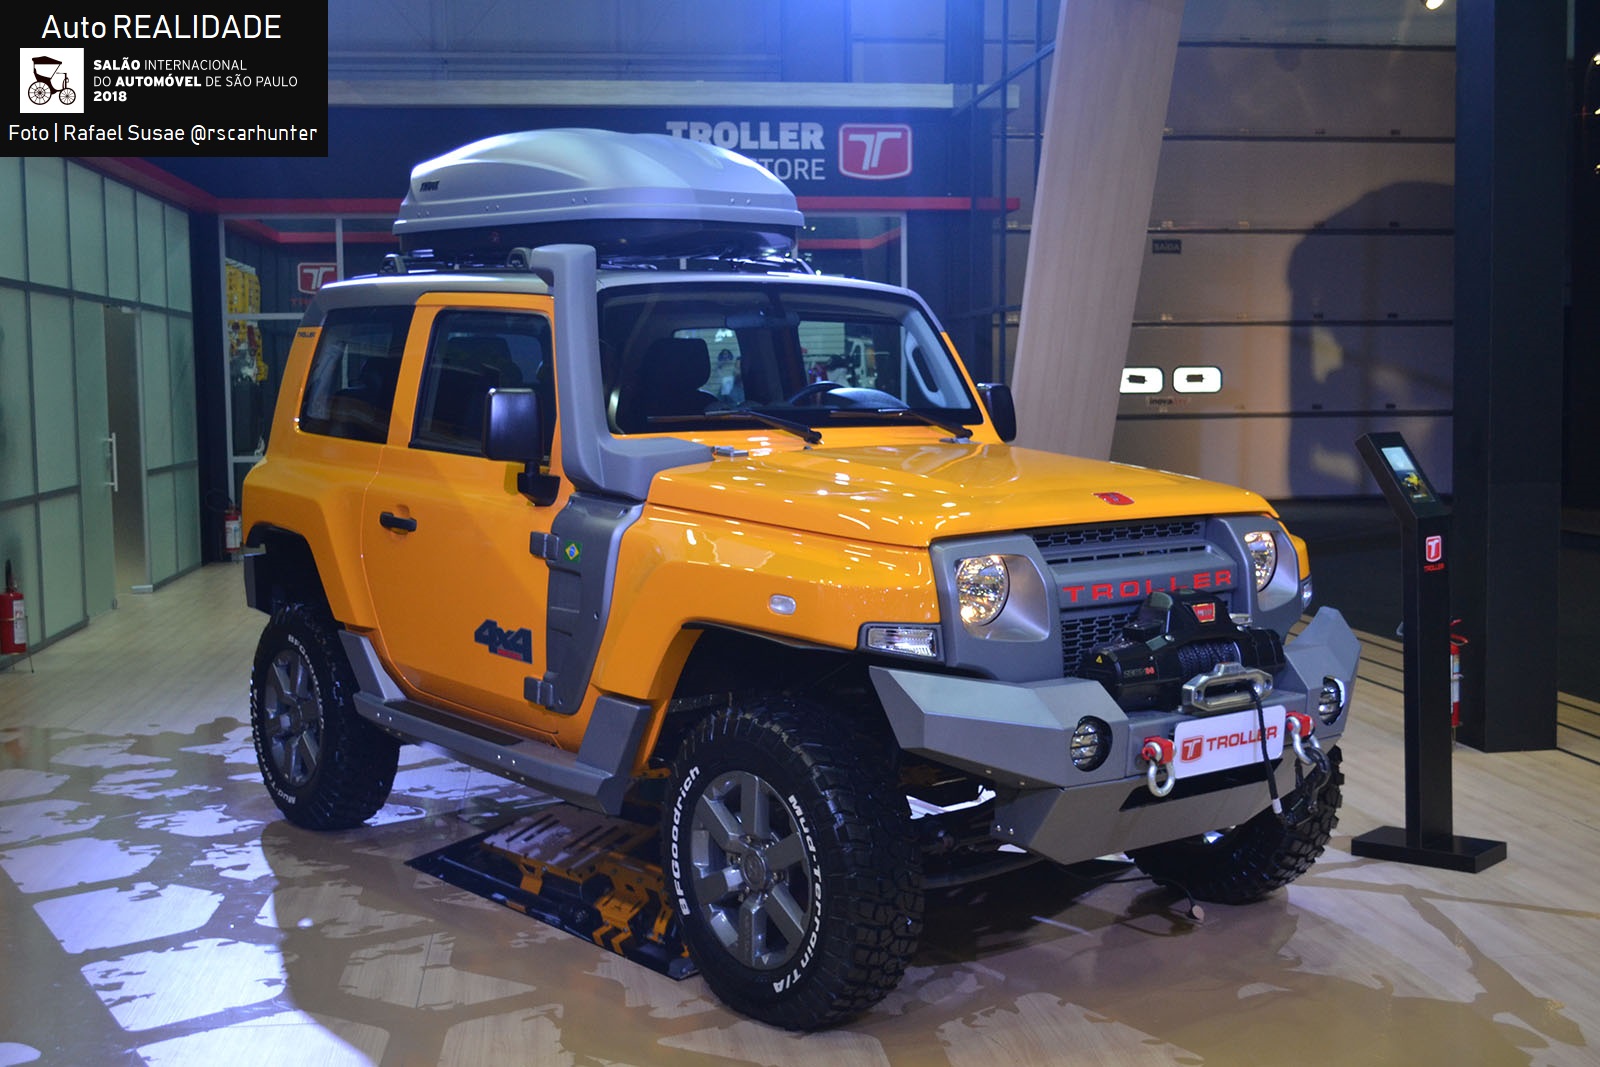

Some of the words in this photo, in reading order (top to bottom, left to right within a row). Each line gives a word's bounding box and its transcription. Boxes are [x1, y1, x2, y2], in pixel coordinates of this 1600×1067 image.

[666, 121, 825, 150] TROLLER
[754, 157, 826, 181] TORE
[1062, 569, 1232, 603] TROLLER
[474, 619, 533, 664] 4x4
[671, 765, 701, 916] BFGoodrich
[772, 971, 802, 994] T/A
